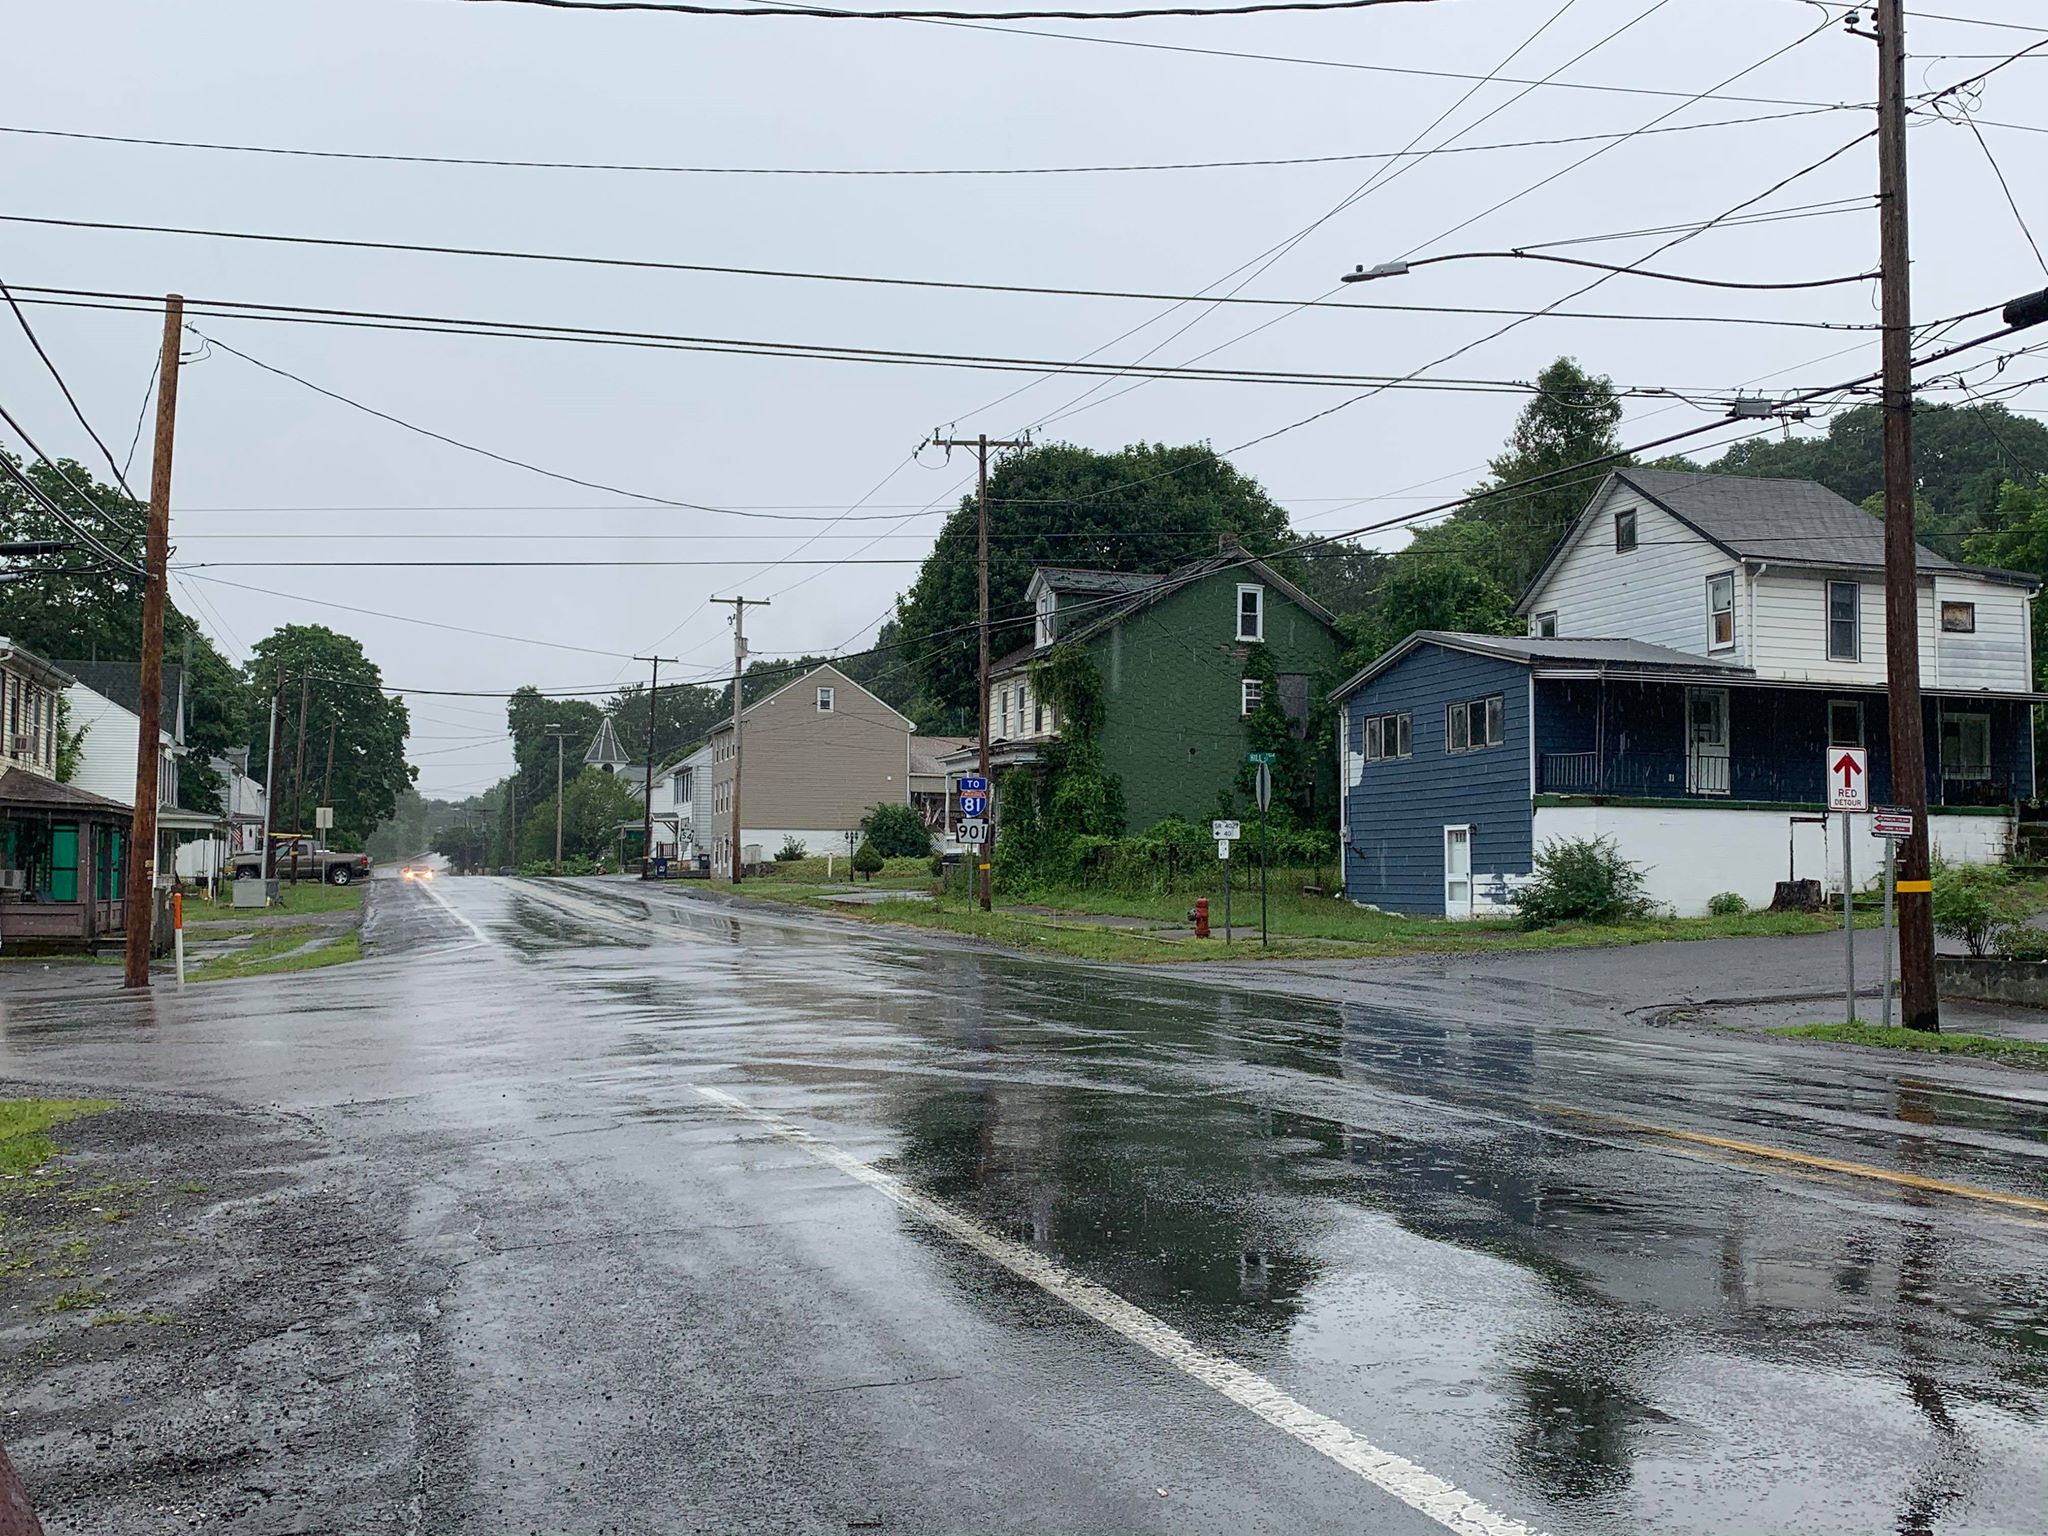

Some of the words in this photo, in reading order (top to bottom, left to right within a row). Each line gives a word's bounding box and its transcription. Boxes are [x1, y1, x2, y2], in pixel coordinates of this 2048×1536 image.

[967, 780, 980, 788] TO
[1838, 789, 1858, 798] RED
[964, 798, 980, 812] 81
[959, 825, 985, 839] 901
